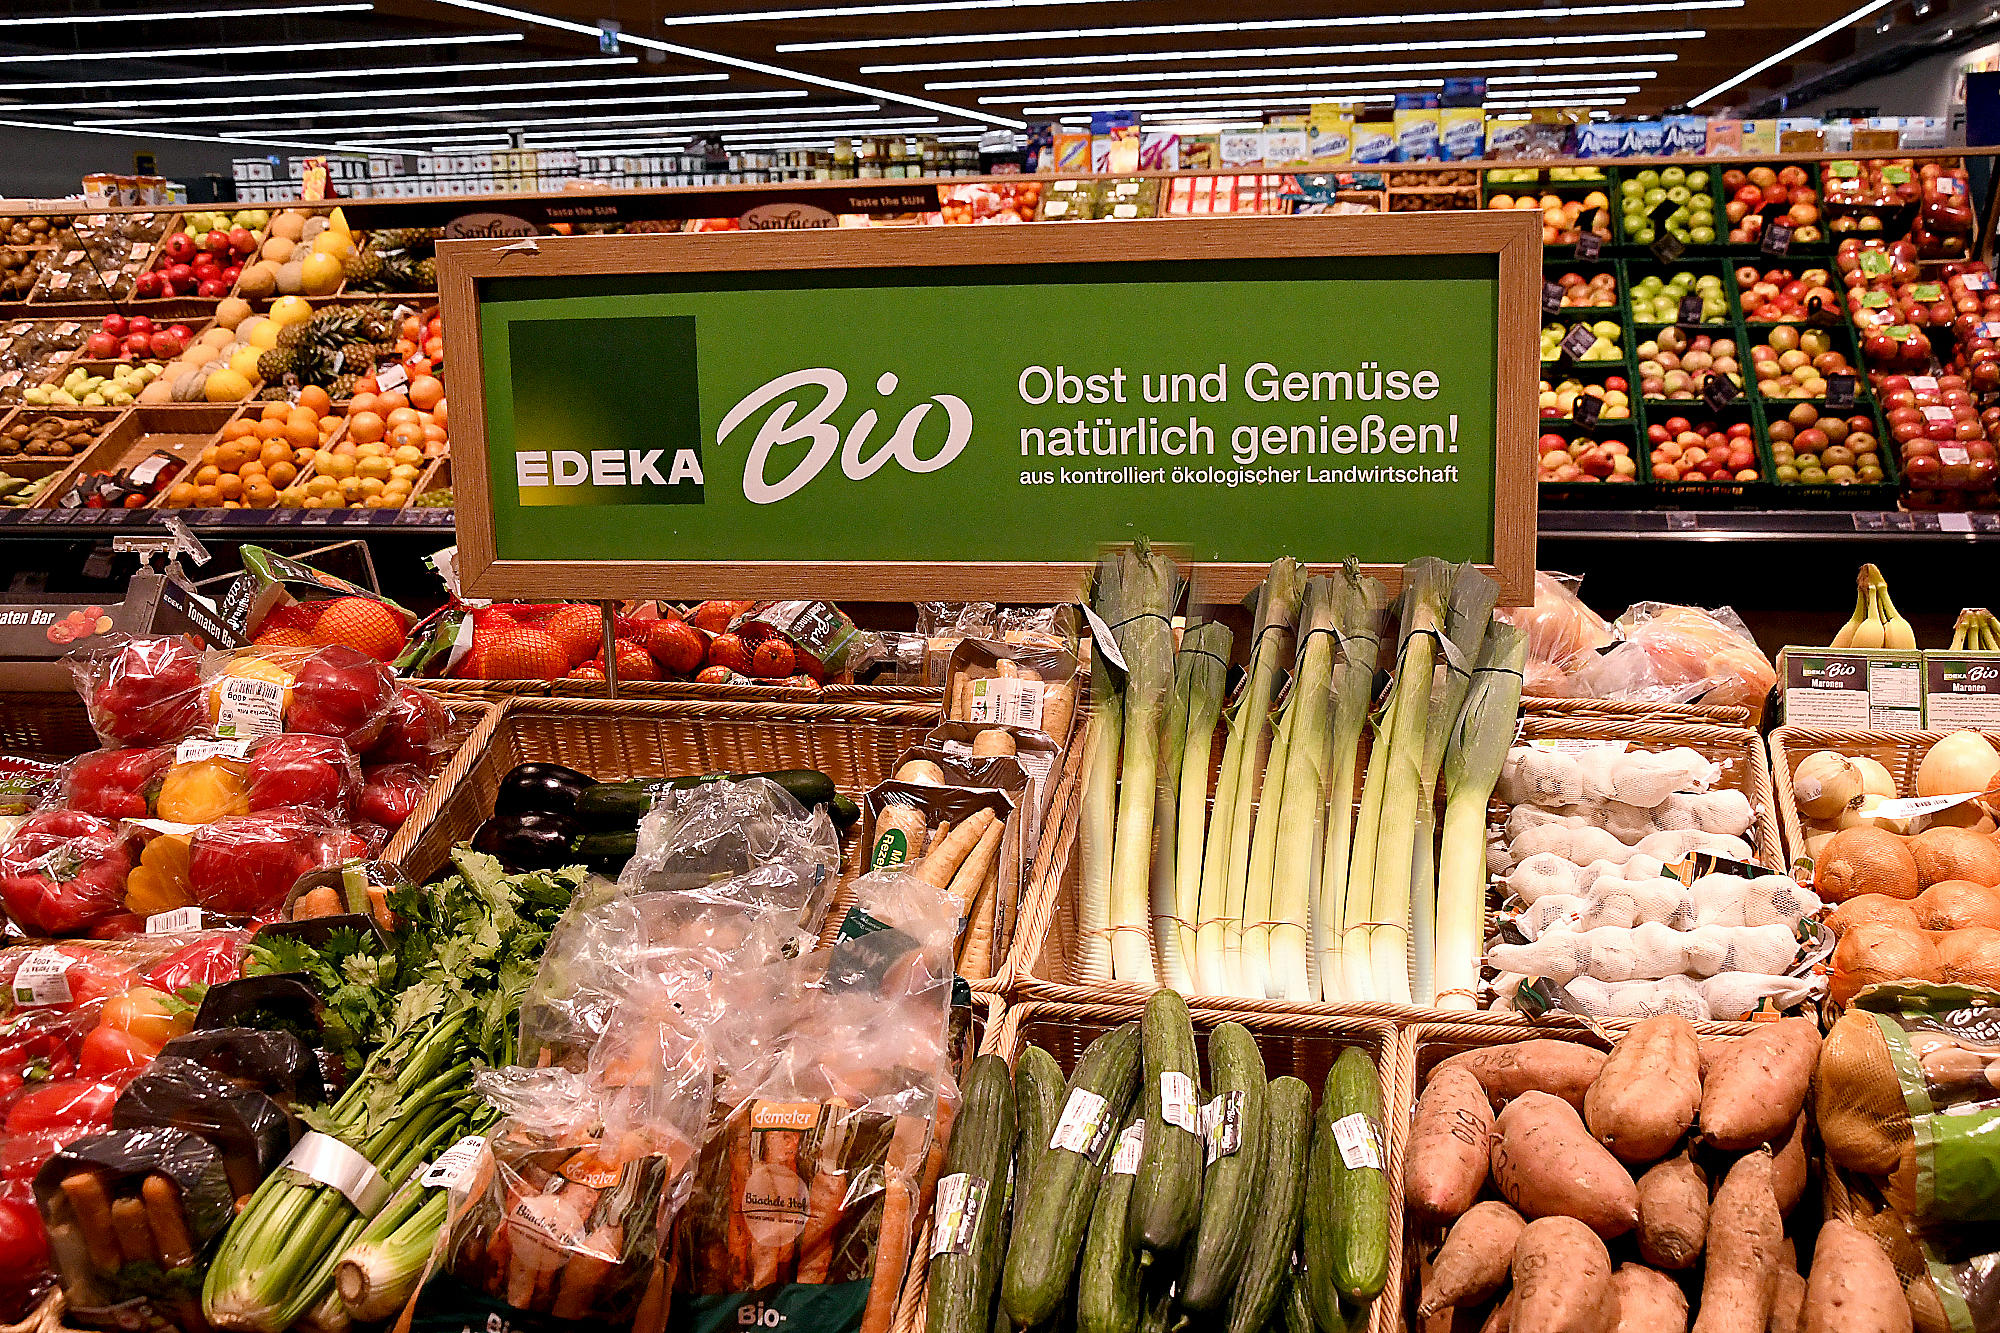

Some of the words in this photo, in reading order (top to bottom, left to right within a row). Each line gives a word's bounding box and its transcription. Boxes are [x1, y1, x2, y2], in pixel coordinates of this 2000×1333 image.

[880, 196, 900, 207] the
[575, 207, 593, 216] the
[1018, 365, 1127, 406] Obst
[1142, 363, 1228, 404] und
[1244, 361, 1441, 402] Gemüse
[716, 367, 973, 505] Bio
[1019, 416, 1215, 457] natürlich
[1231, 413, 1460, 465] genießen!
[515, 448, 704, 488] EDEKA
[1019, 469, 1055, 486] aus
[1059, 466, 1167, 485] kontrolliert
[1171, 466, 1302, 489] ökologischer
[1306, 465, 1459, 484] Landwirtschaft
[30, 609, 56, 625] Bar
[188, 602, 221, 640] Tomaten
[221, 628, 237, 649] Bar
[1826, 662, 1857, 678] Bio
[1968, 666, 1999, 681] Bio
[1811, 678, 1844, 689] Maronen
[1953, 682, 1987, 693] Maronen
[755, 1106, 812, 1125] demeter
[788, 1197, 807, 1212] Hof
[737, 1300, 787, 1328] Bio-
